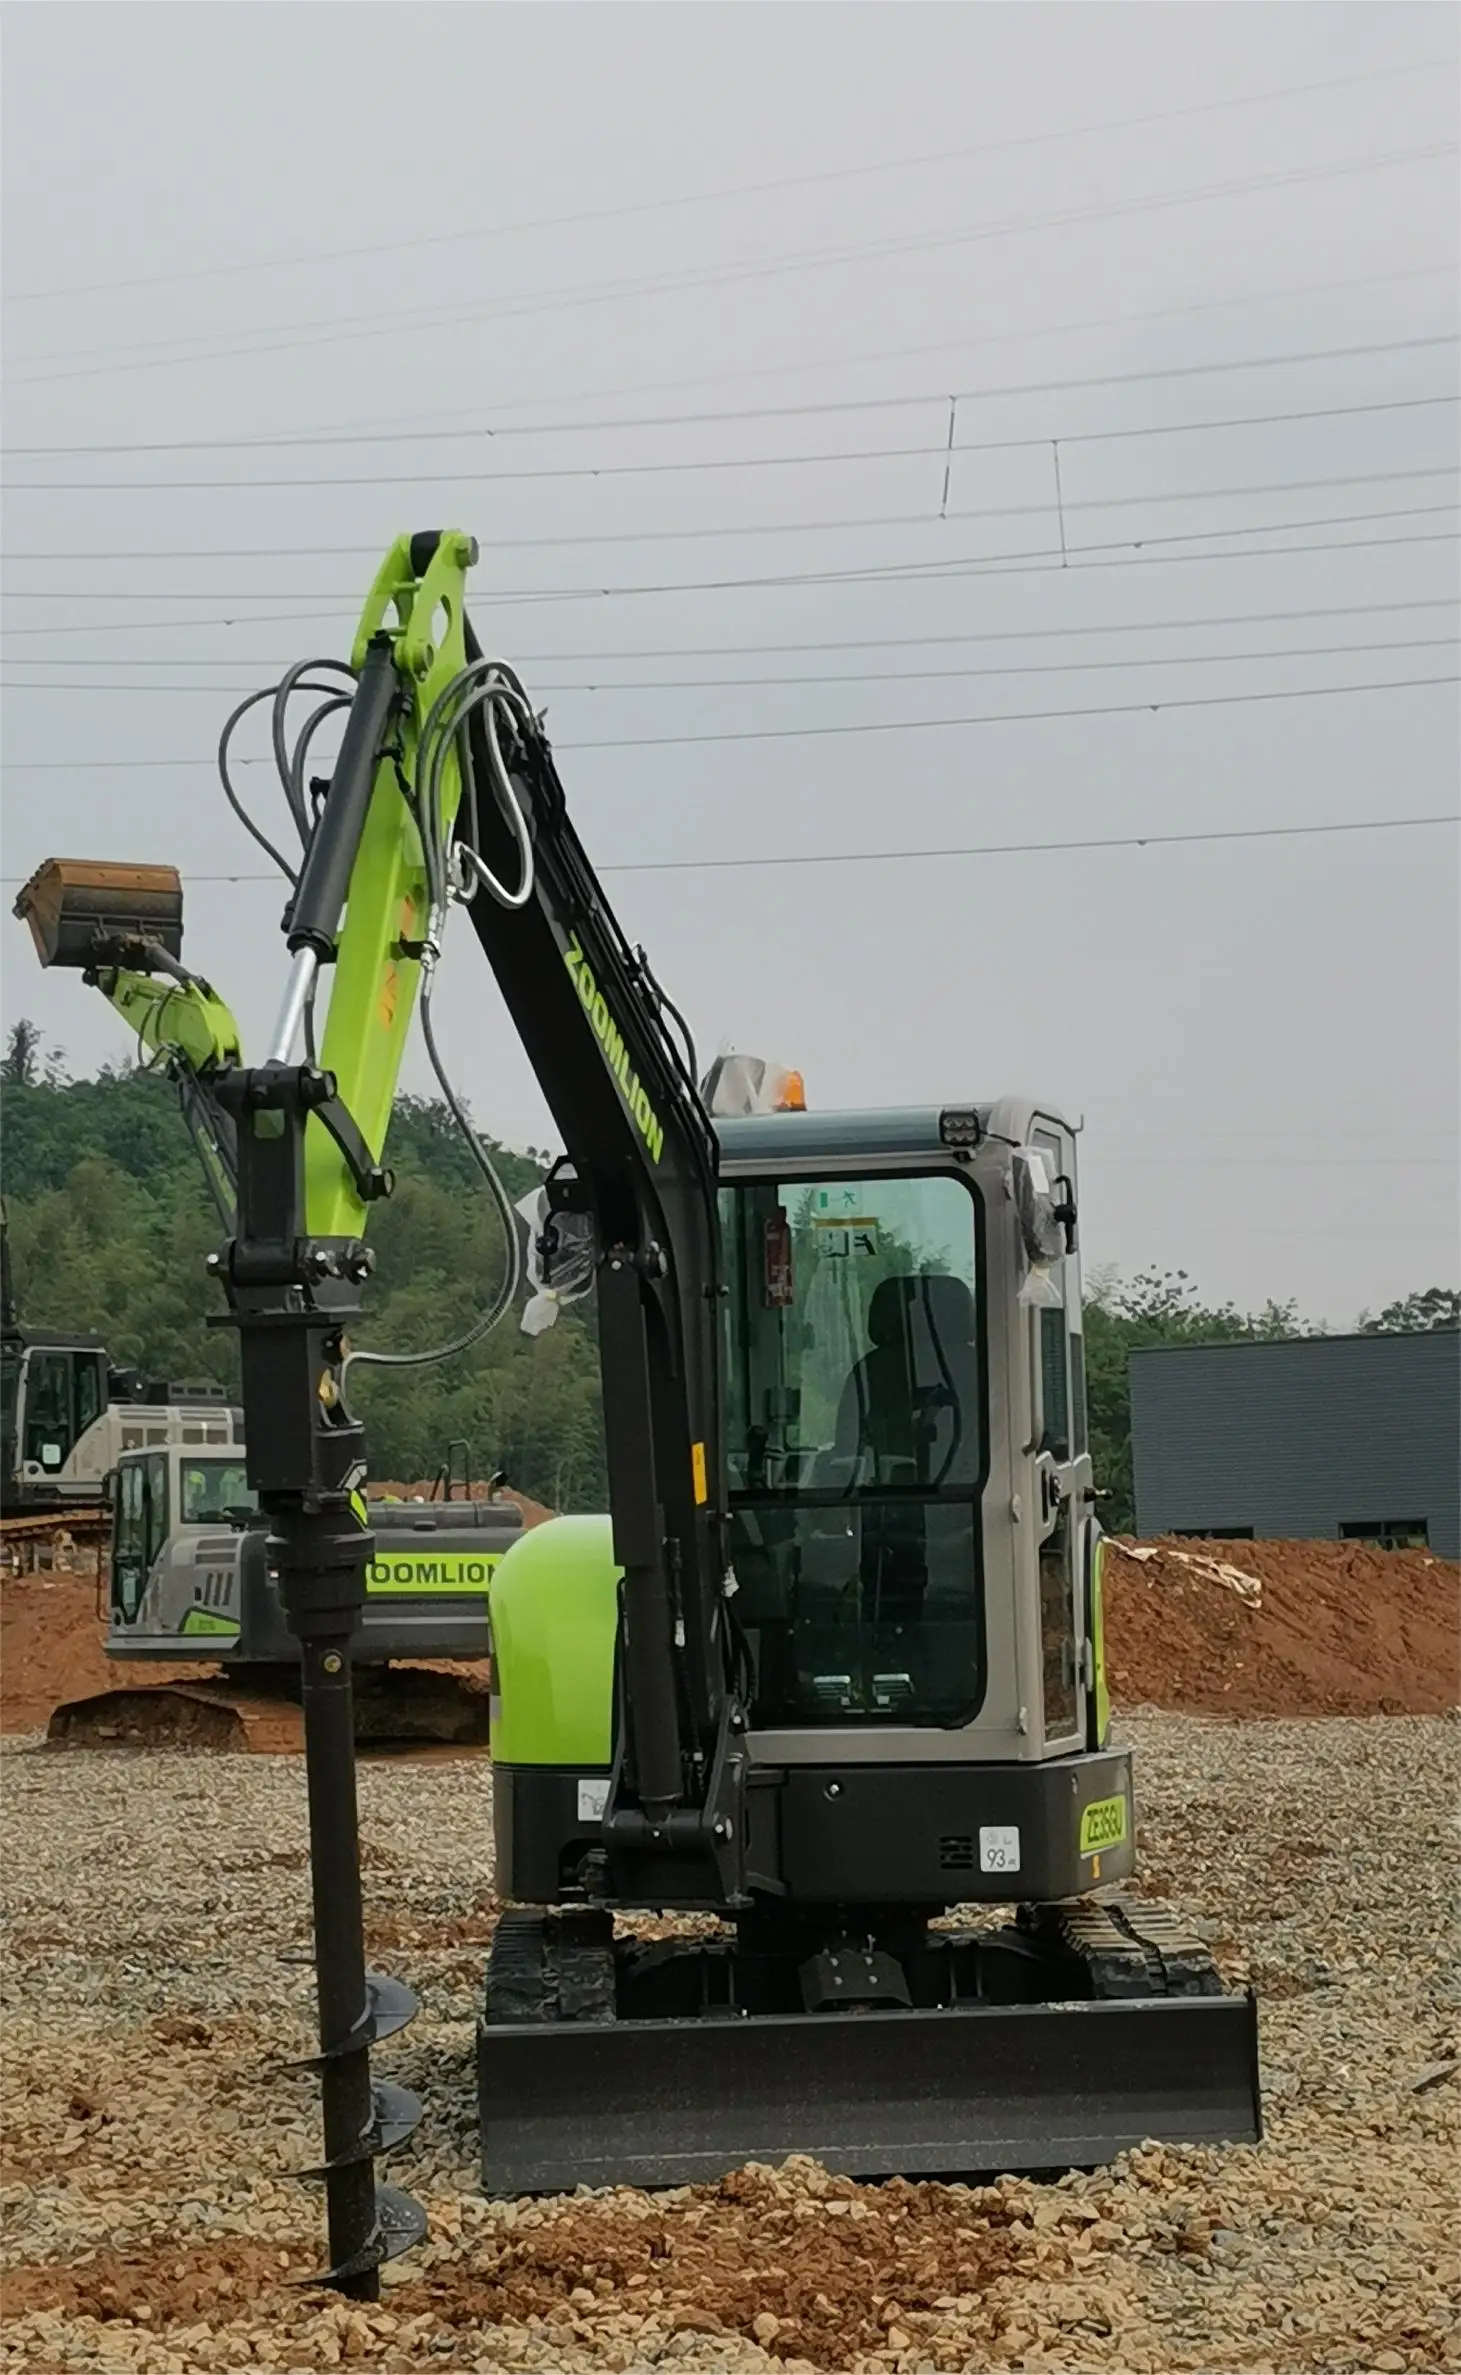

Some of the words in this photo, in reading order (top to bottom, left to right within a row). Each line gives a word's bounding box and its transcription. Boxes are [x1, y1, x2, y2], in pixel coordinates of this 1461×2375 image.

[563, 928, 664, 1165] ZOOMLION
[371, 1562, 496, 1584] OOMLIO
[987, 1848, 1006, 1868] 93
